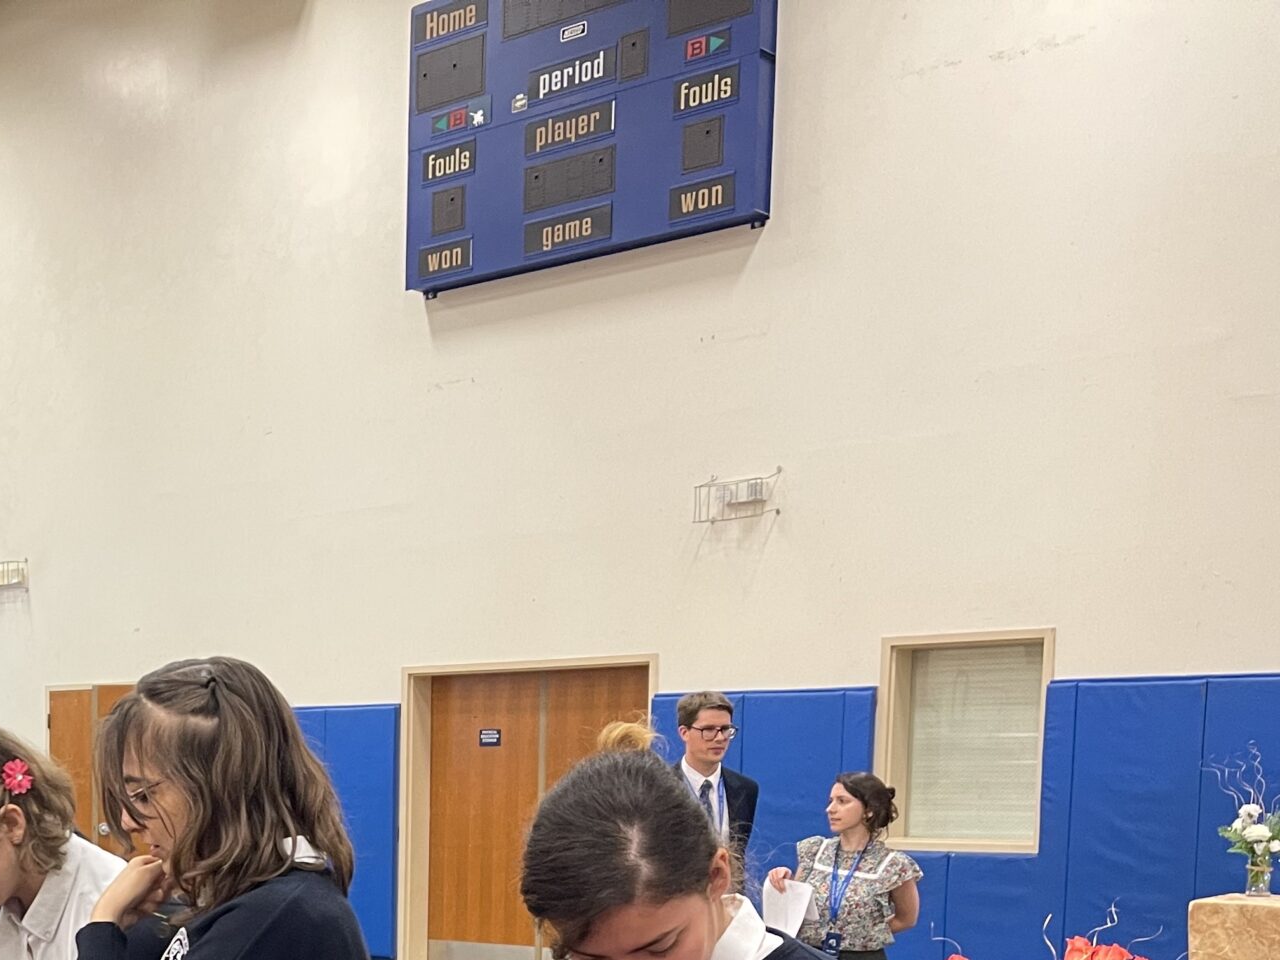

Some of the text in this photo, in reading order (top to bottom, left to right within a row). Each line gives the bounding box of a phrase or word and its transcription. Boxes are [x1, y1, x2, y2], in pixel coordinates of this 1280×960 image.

[426, 4, 477, 40] Home
[539, 50, 604, 99] period
[680, 74, 732, 110] fouls
[536, 111, 600, 153] player
[428, 148, 470, 179] fouls
[681, 184, 723, 213] won
[542, 217, 592, 251] game
[427, 247, 461, 272] won
